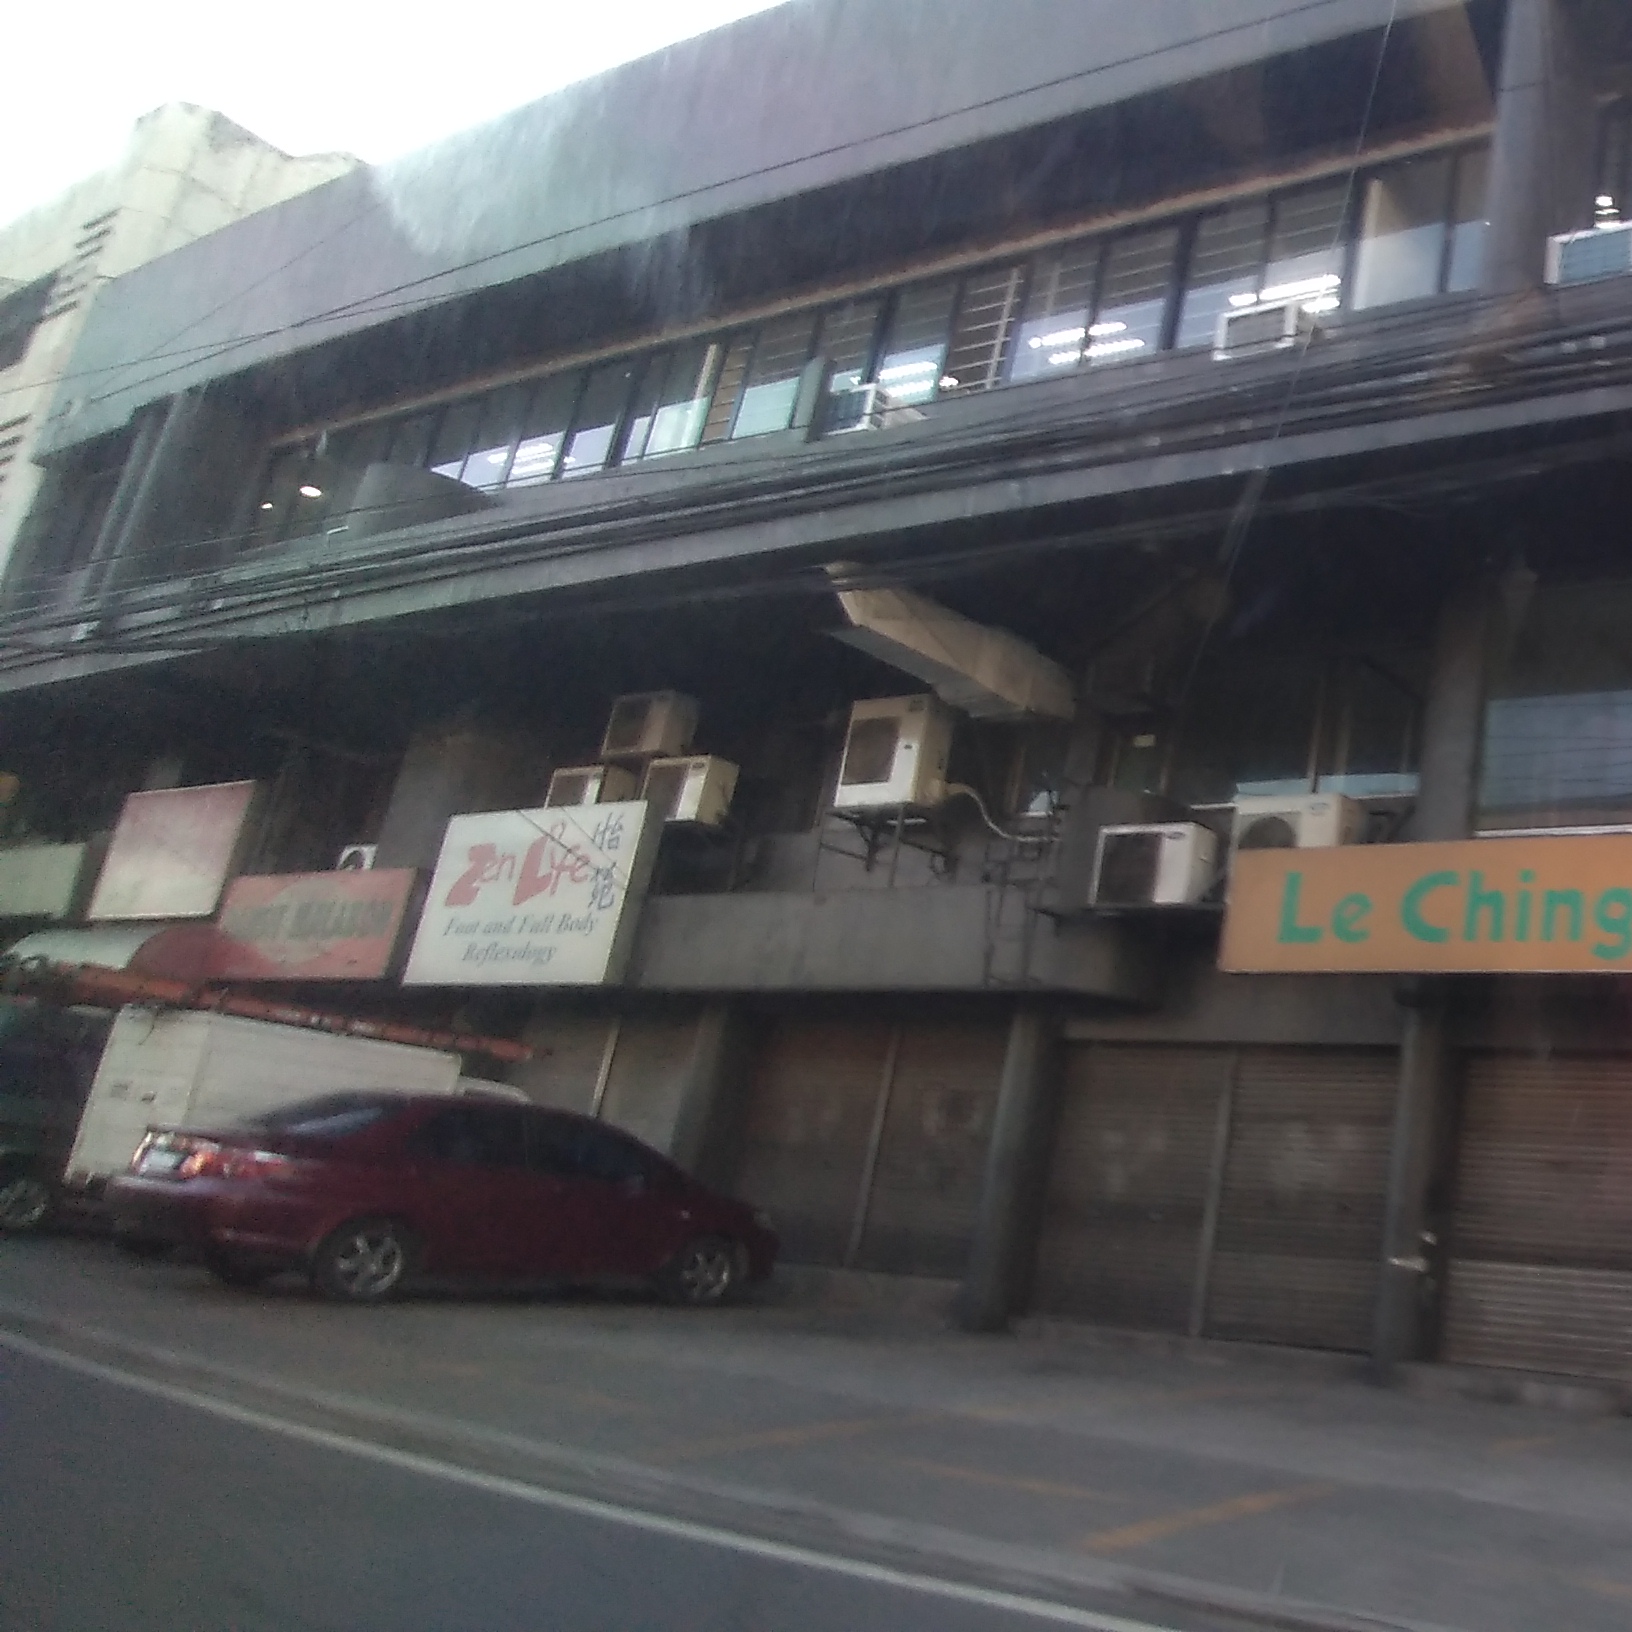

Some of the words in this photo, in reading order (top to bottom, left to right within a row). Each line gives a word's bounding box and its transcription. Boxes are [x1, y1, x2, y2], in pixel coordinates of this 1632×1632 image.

[444, 843, 517, 907] Zen
[512, 820, 592, 906] Life
[443, 917, 480, 937] Foot
[483, 914, 516, 934] and
[517, 914, 552, 934] Full
[555, 912, 598, 937] Body
[1276, 871, 1374, 944] Le
[461, 940, 557, 969] Reflexology
